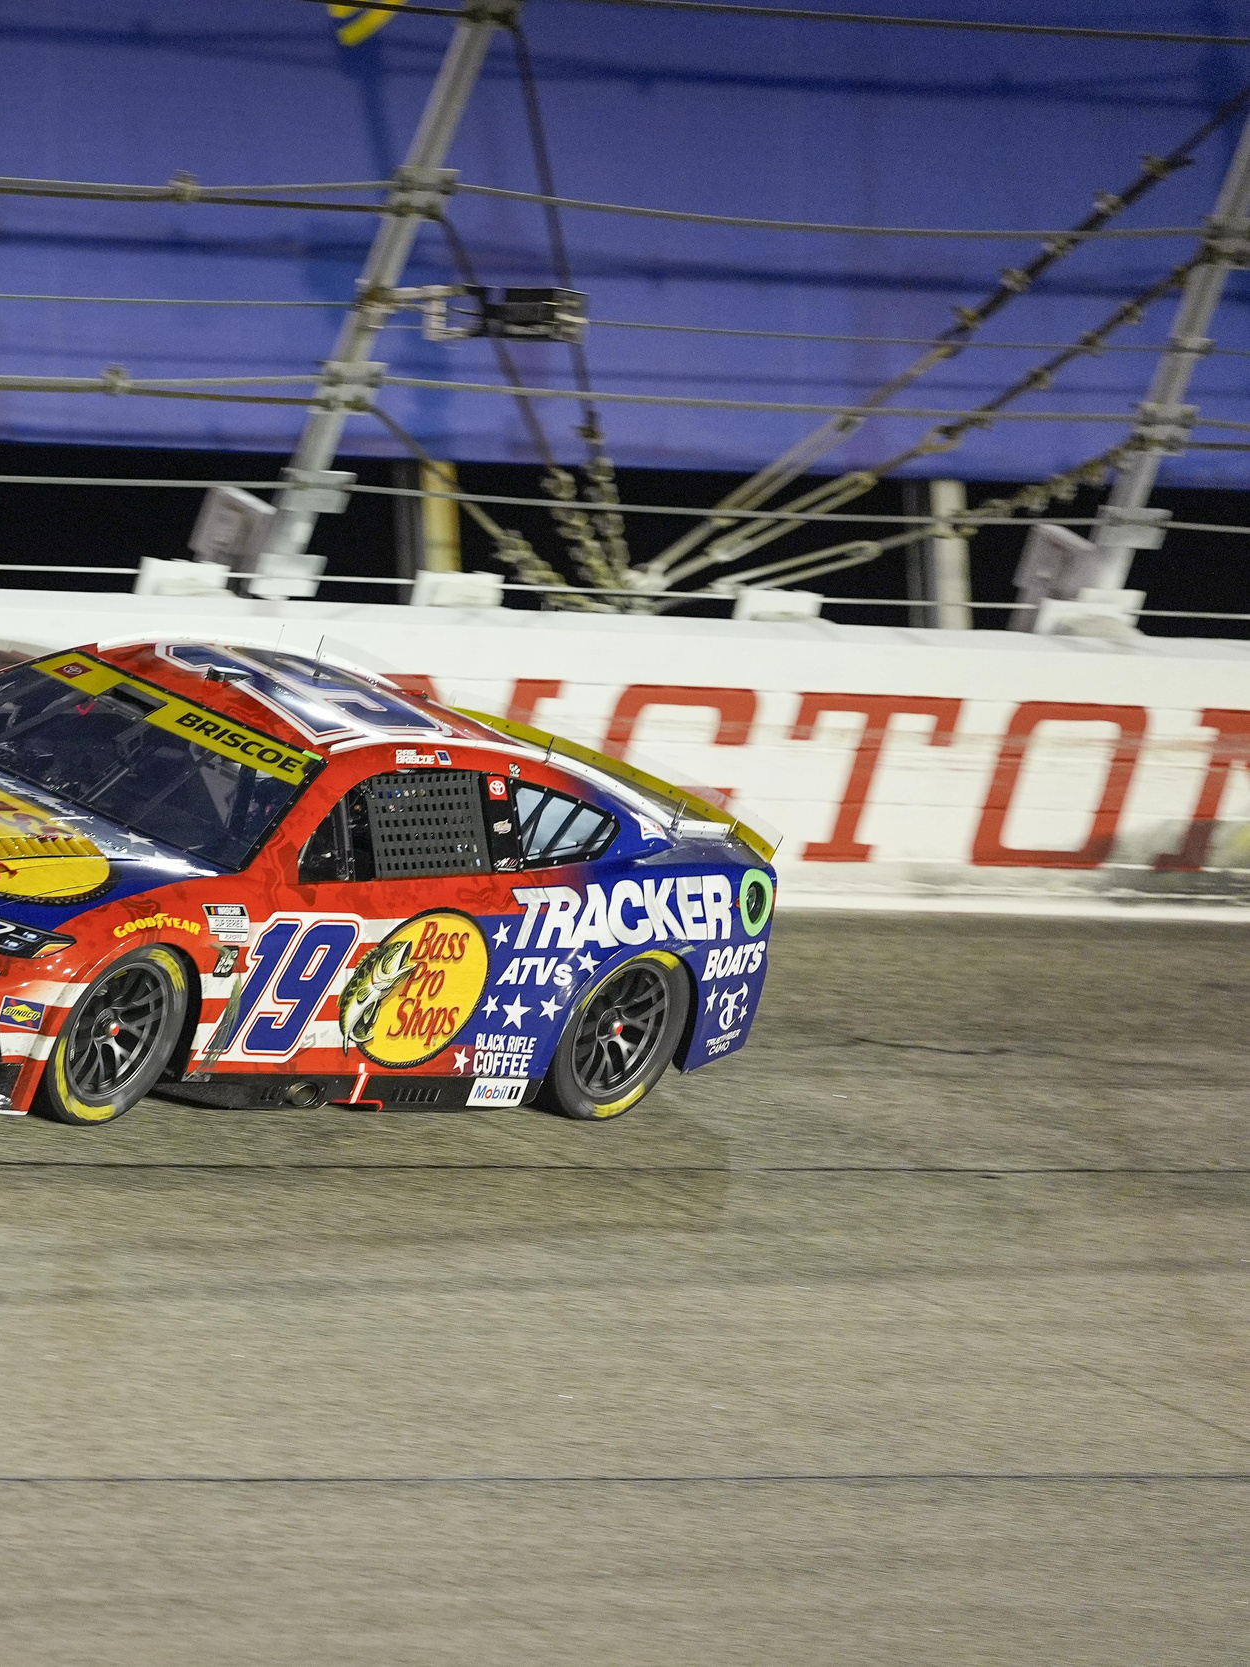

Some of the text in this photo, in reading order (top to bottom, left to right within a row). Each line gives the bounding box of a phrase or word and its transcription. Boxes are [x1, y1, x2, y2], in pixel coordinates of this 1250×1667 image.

[175, 711, 303, 773] BRISCOE
[396, 755, 435, 765] BRISCOE
[113, 912, 202, 938] GOODYEAR
[511, 874, 732, 949] TRACKER
[410, 921, 470, 961] Bass
[495, 957, 573, 986] ATVs
[701, 941, 766, 981] BOATS
[201, 917, 360, 1057] 19
[399, 961, 446, 998] Pro
[2, 1006, 42, 1021] SUNOCO
[387, 998, 460, 1047] Shops
[475, 1033, 538, 1054] BLACK RIFLE
[708, 1041, 731, 1056] CAMO
[472, 1051, 533, 1077] COFFEE
[474, 1085, 521, 1100] Mobil 1
